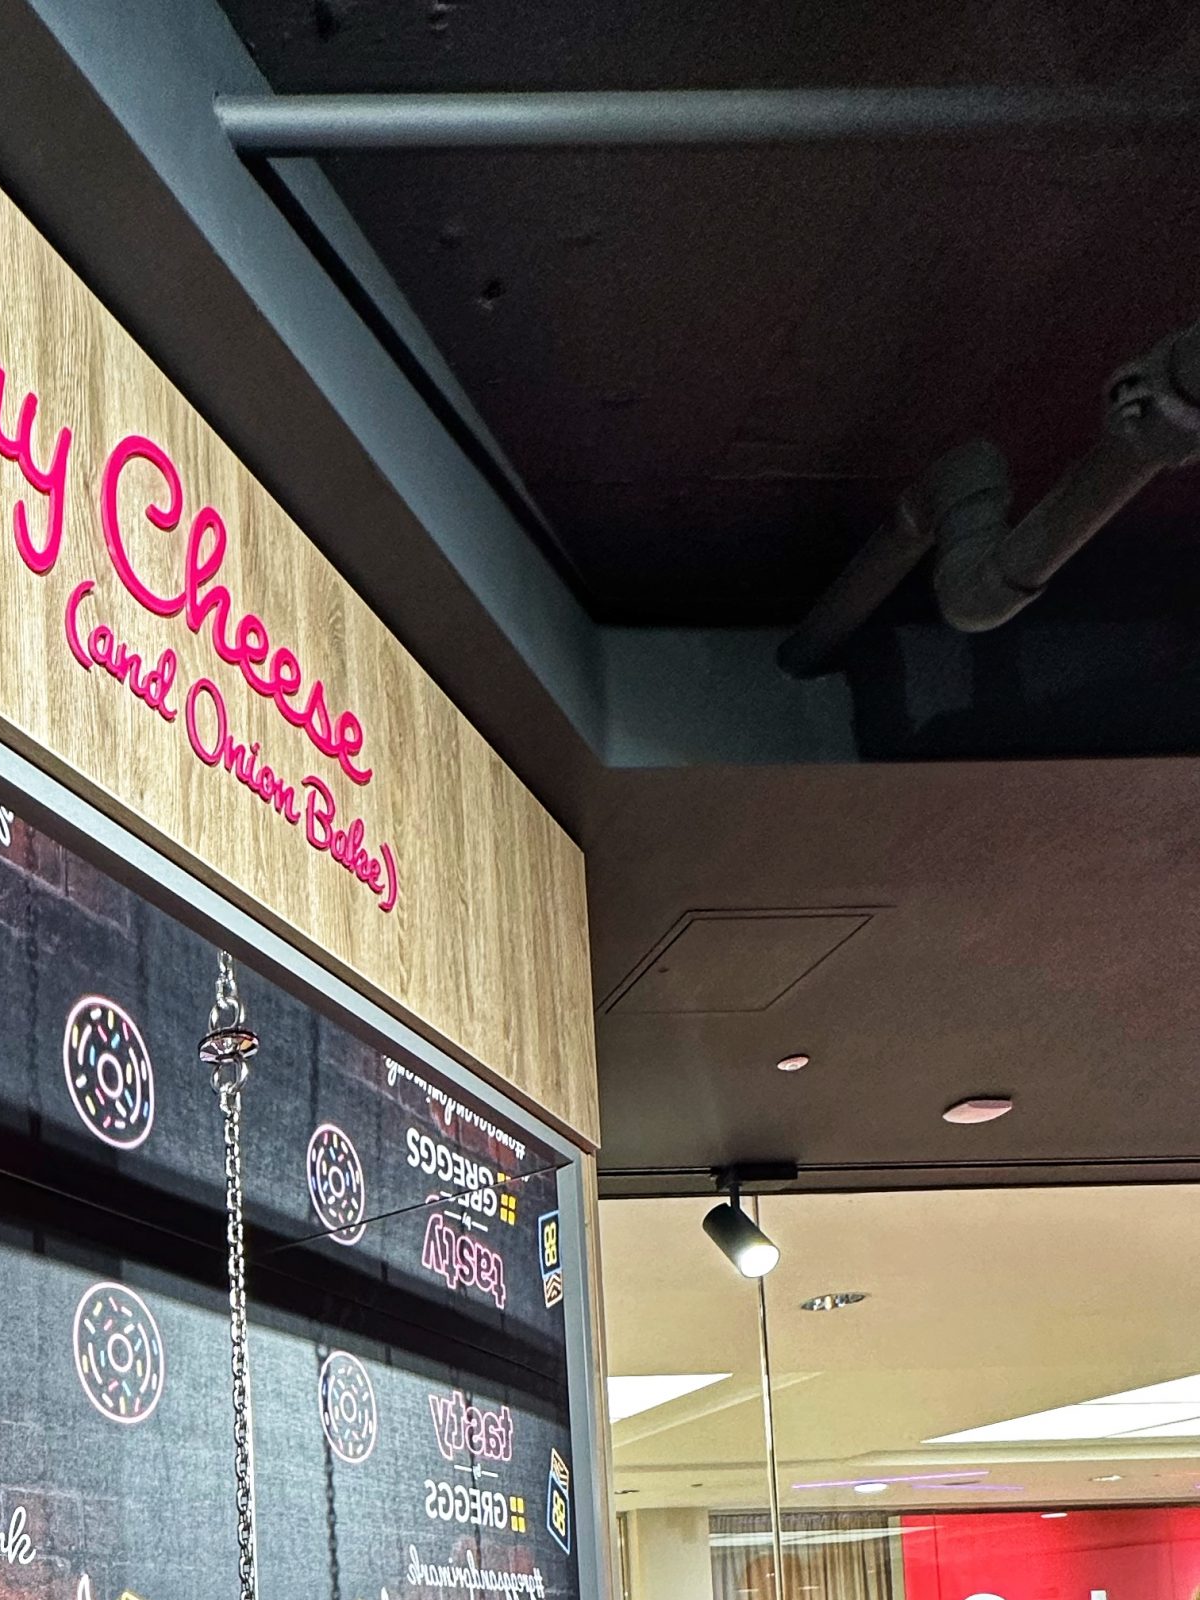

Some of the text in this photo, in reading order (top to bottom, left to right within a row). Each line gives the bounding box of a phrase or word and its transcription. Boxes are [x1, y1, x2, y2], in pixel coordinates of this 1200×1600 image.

[65, 580, 178, 722] (and
[186, 677, 300, 824] Onion
[302, 775, 397, 913] Bake)
[101, 434, 373, 784] Cheese
